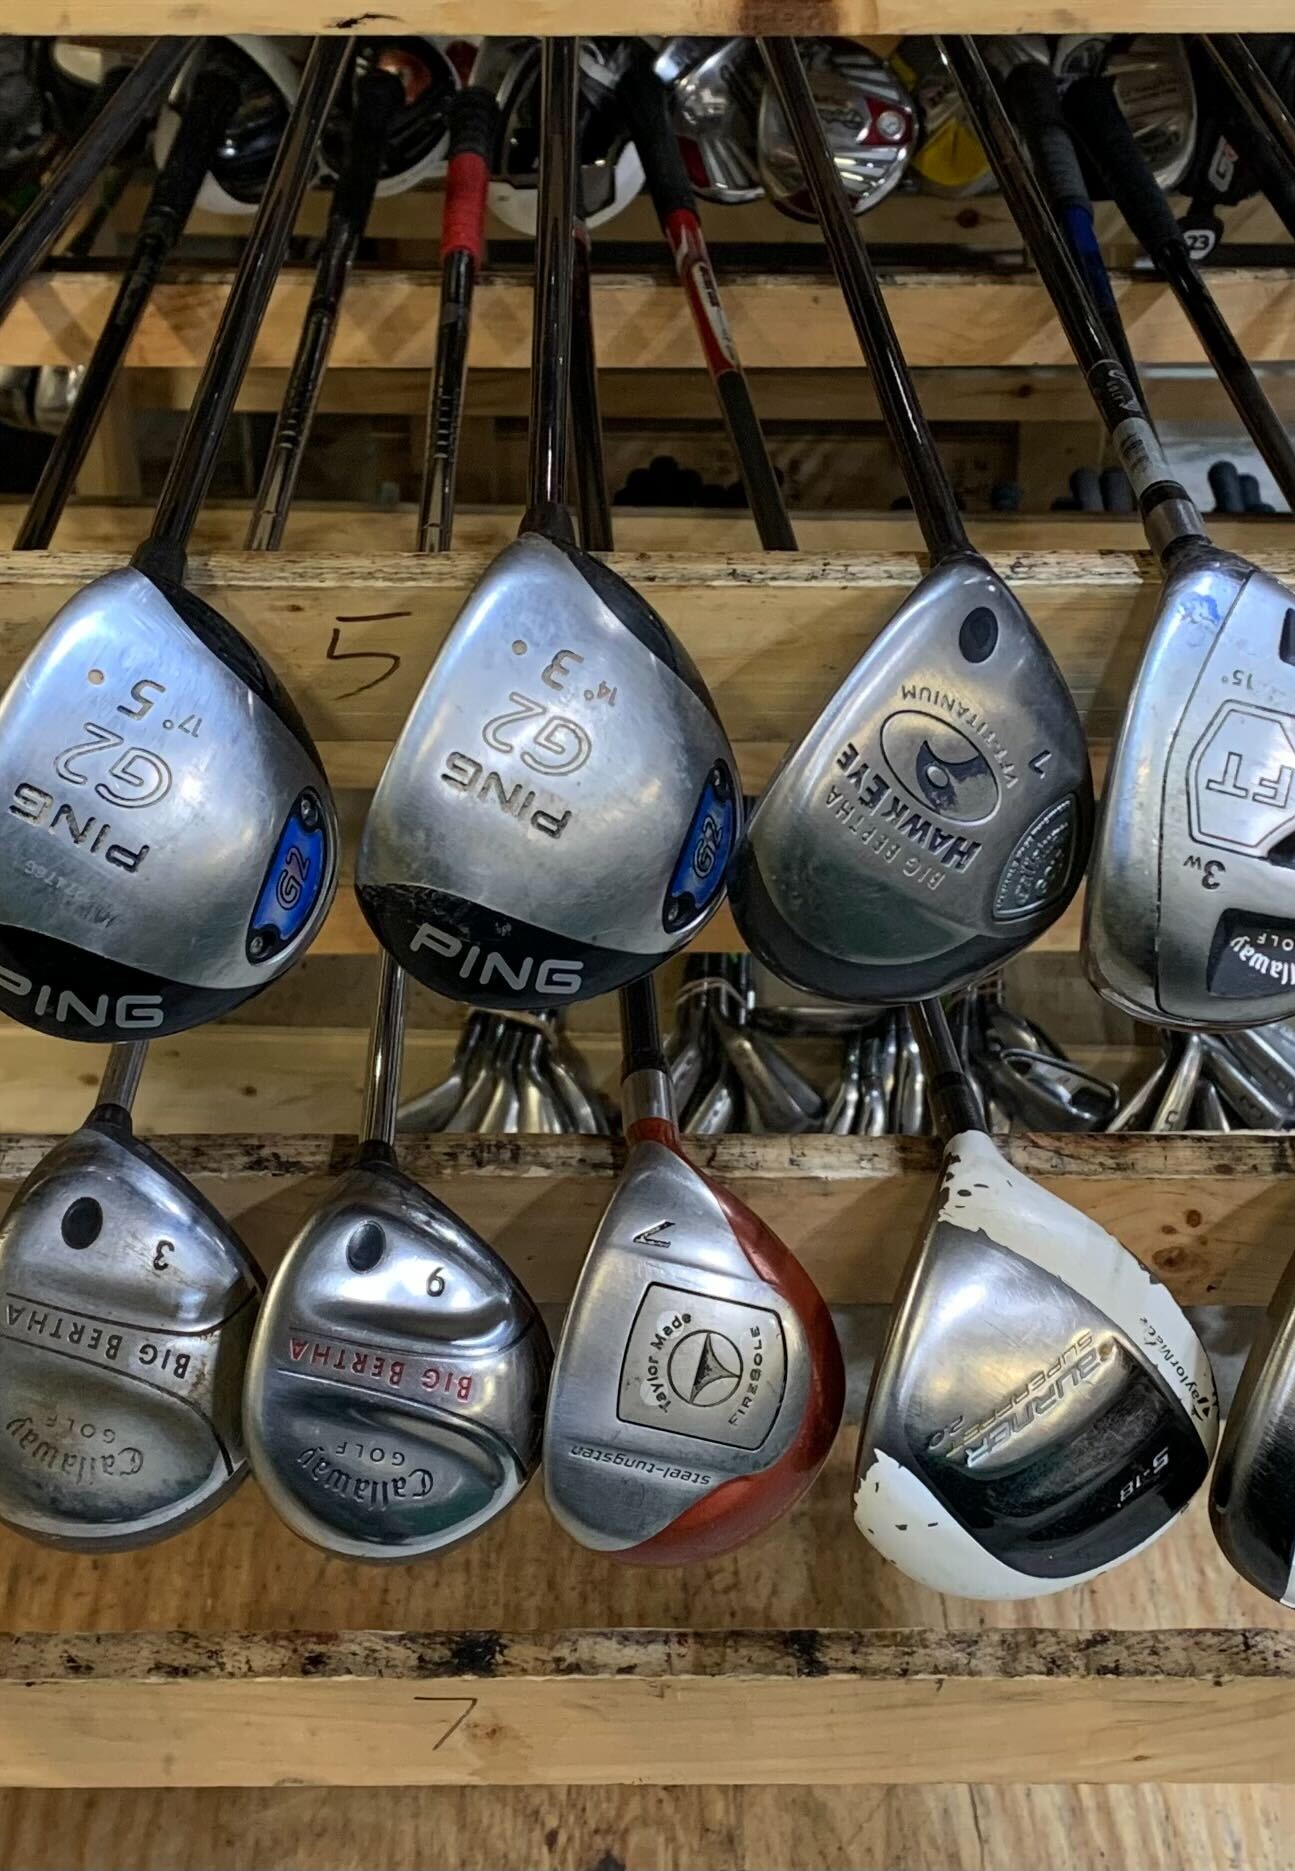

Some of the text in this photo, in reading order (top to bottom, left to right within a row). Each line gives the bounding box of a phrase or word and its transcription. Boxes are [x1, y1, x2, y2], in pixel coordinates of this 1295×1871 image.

[326, 610, 412, 700] 5
[540, 649, 585, 691] 3
[116, 678, 166, 721] 5
[54, 721, 173, 809] G2
[481, 690, 593, 777] G2
[440, 750, 574, 840] PING
[836, 742, 983, 874] HAWKEYE
[1205, 750, 1295, 809] FT
[8, 781, 151, 874] PING
[692, 816, 725, 879] G2
[276, 846, 311, 911] G2
[409, 922, 585, 995] PING
[152, 1239, 175, 1272] 3
[632, 1218, 676, 1249] 7
[5, 1303, 192, 1380] BIG BERTHA
[288, 1336, 474, 1401] BIG BERTHA
[647, 1313, 693, 1415] Taylor Made
[727, 1325, 761, 1427] FIRESOLE
[946, 1329, 1095, 1458] SUPERFAST
[965, 1344, 1117, 1468] BURNER
[6, 1417, 144, 1484] Callaway
[43, 1413, 117, 1444] GOLF
[335, 1441, 406, 1467] GOLF
[297, 1446, 434, 1511] Callaway
[568, 1444, 713, 1486] steel-tungsten
[412, 1694, 479, 1752] 7
